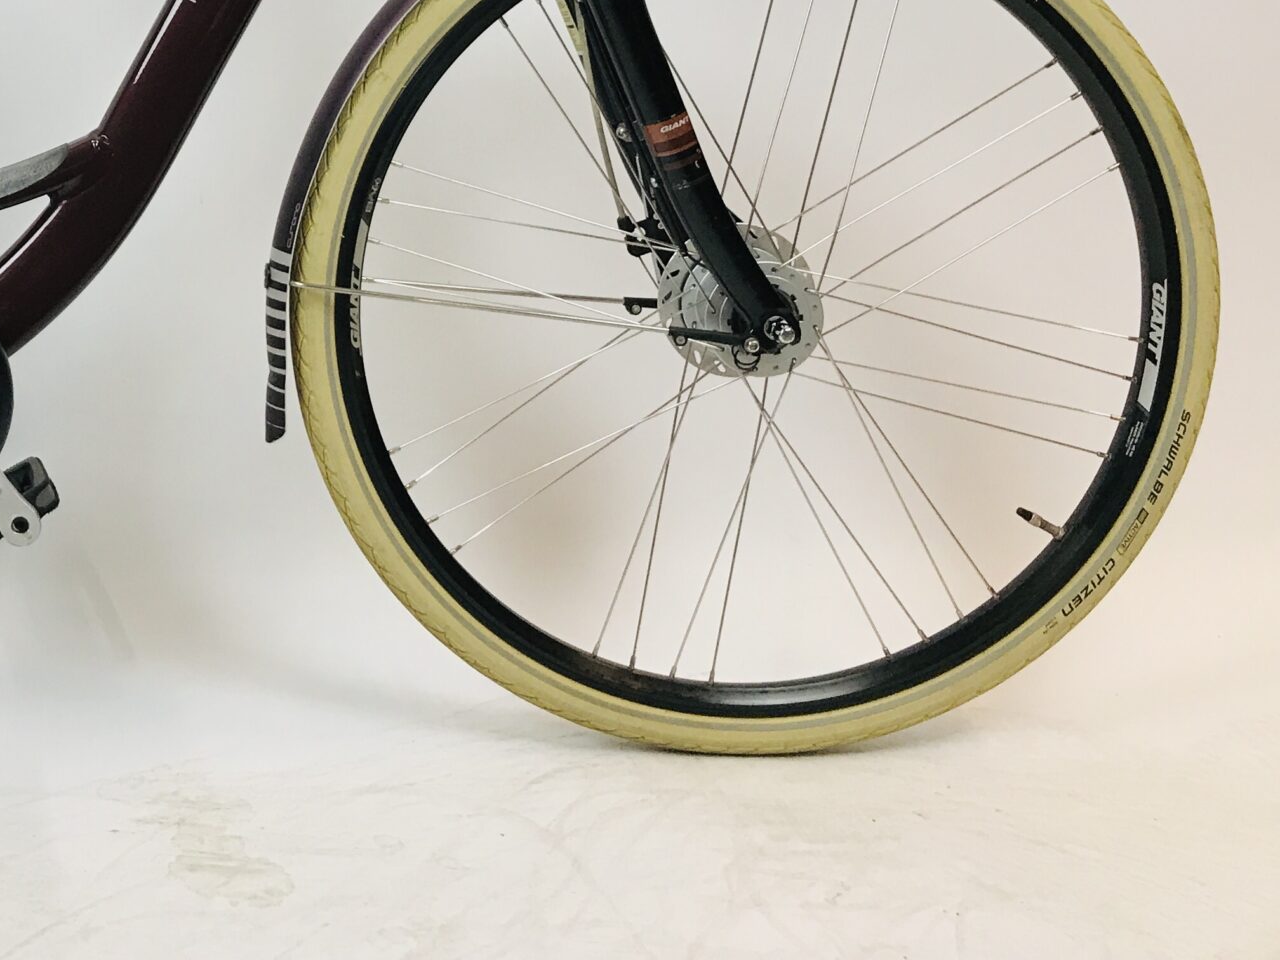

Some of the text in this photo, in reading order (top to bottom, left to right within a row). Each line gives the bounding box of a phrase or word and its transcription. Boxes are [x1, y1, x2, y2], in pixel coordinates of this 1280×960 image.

[349, 269, 361, 349] GIANT
[1147, 280, 1167, 362] GIANT
[1147, 408, 1192, 506] SCHWALBE
[1061, 557, 1116, 618] CITIZEN
